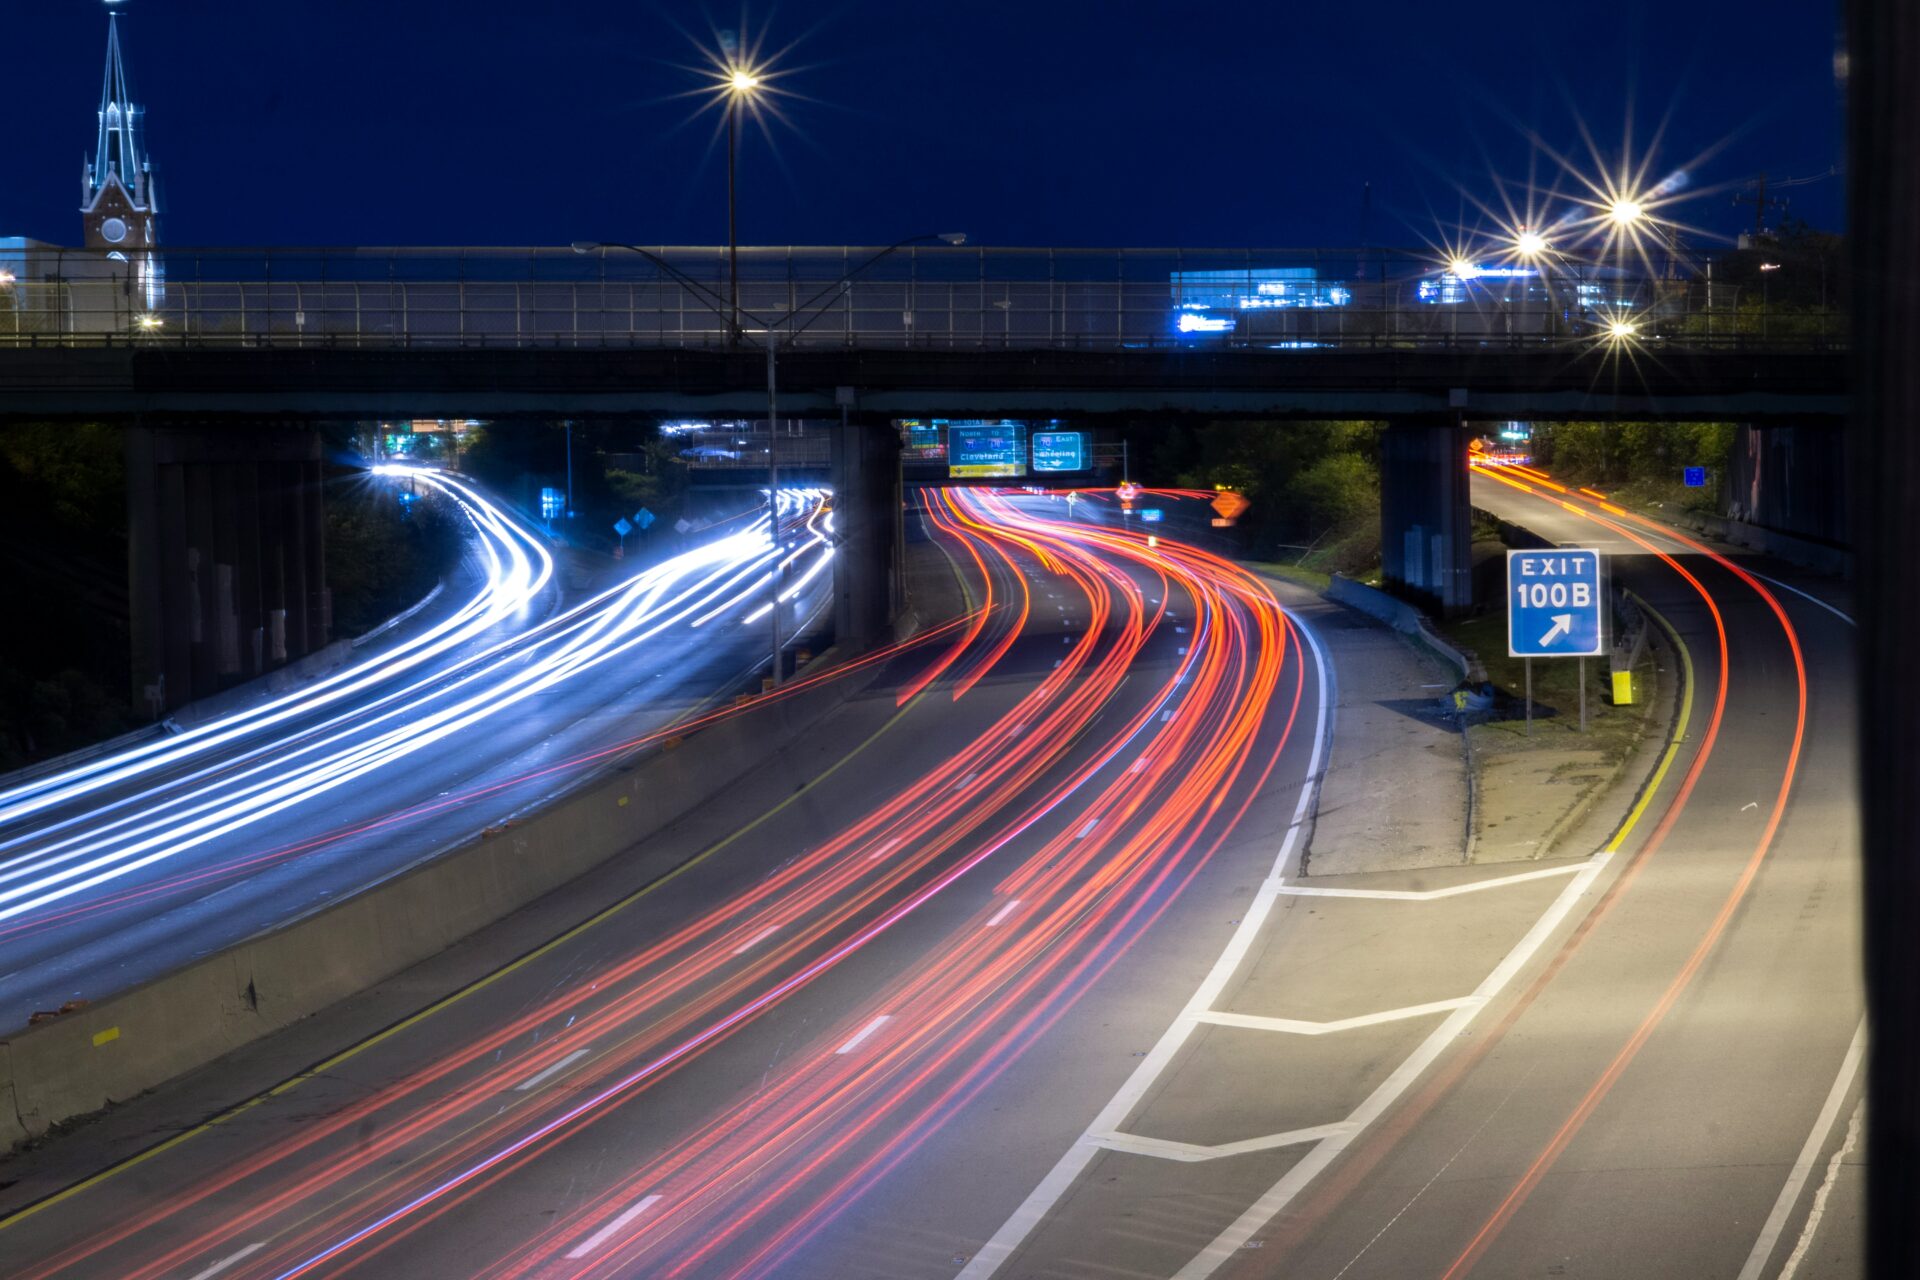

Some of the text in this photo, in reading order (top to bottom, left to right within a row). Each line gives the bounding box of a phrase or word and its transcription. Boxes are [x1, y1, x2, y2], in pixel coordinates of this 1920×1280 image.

[960, 452, 1004, 460] Cleveland
[1522, 558, 1585, 576] EXIT
[1518, 582, 1590, 608] 100B
